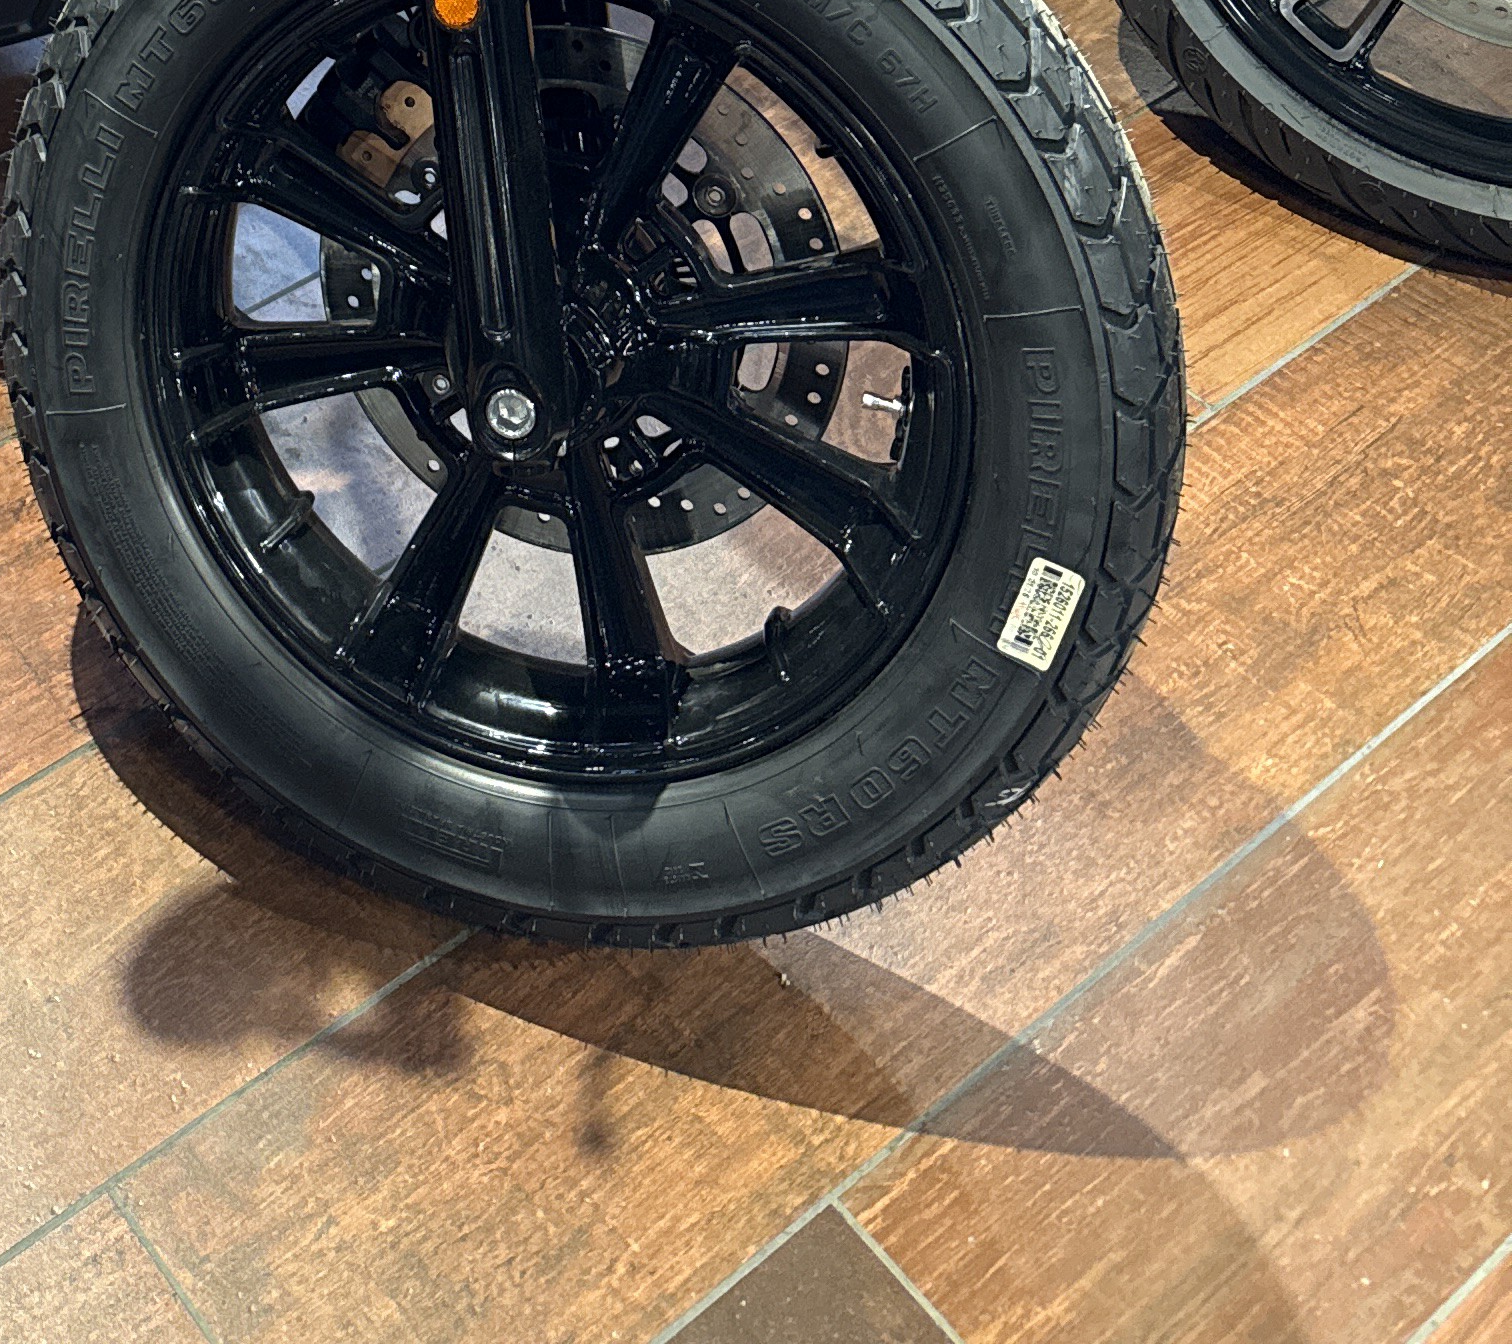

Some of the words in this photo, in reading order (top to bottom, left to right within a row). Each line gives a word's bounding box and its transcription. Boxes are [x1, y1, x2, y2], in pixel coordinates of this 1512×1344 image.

[875, 51, 941, 117] 67H
[63, 123, 126, 395] PIRELLI
[759, 656, 999, 856] MT60RS
